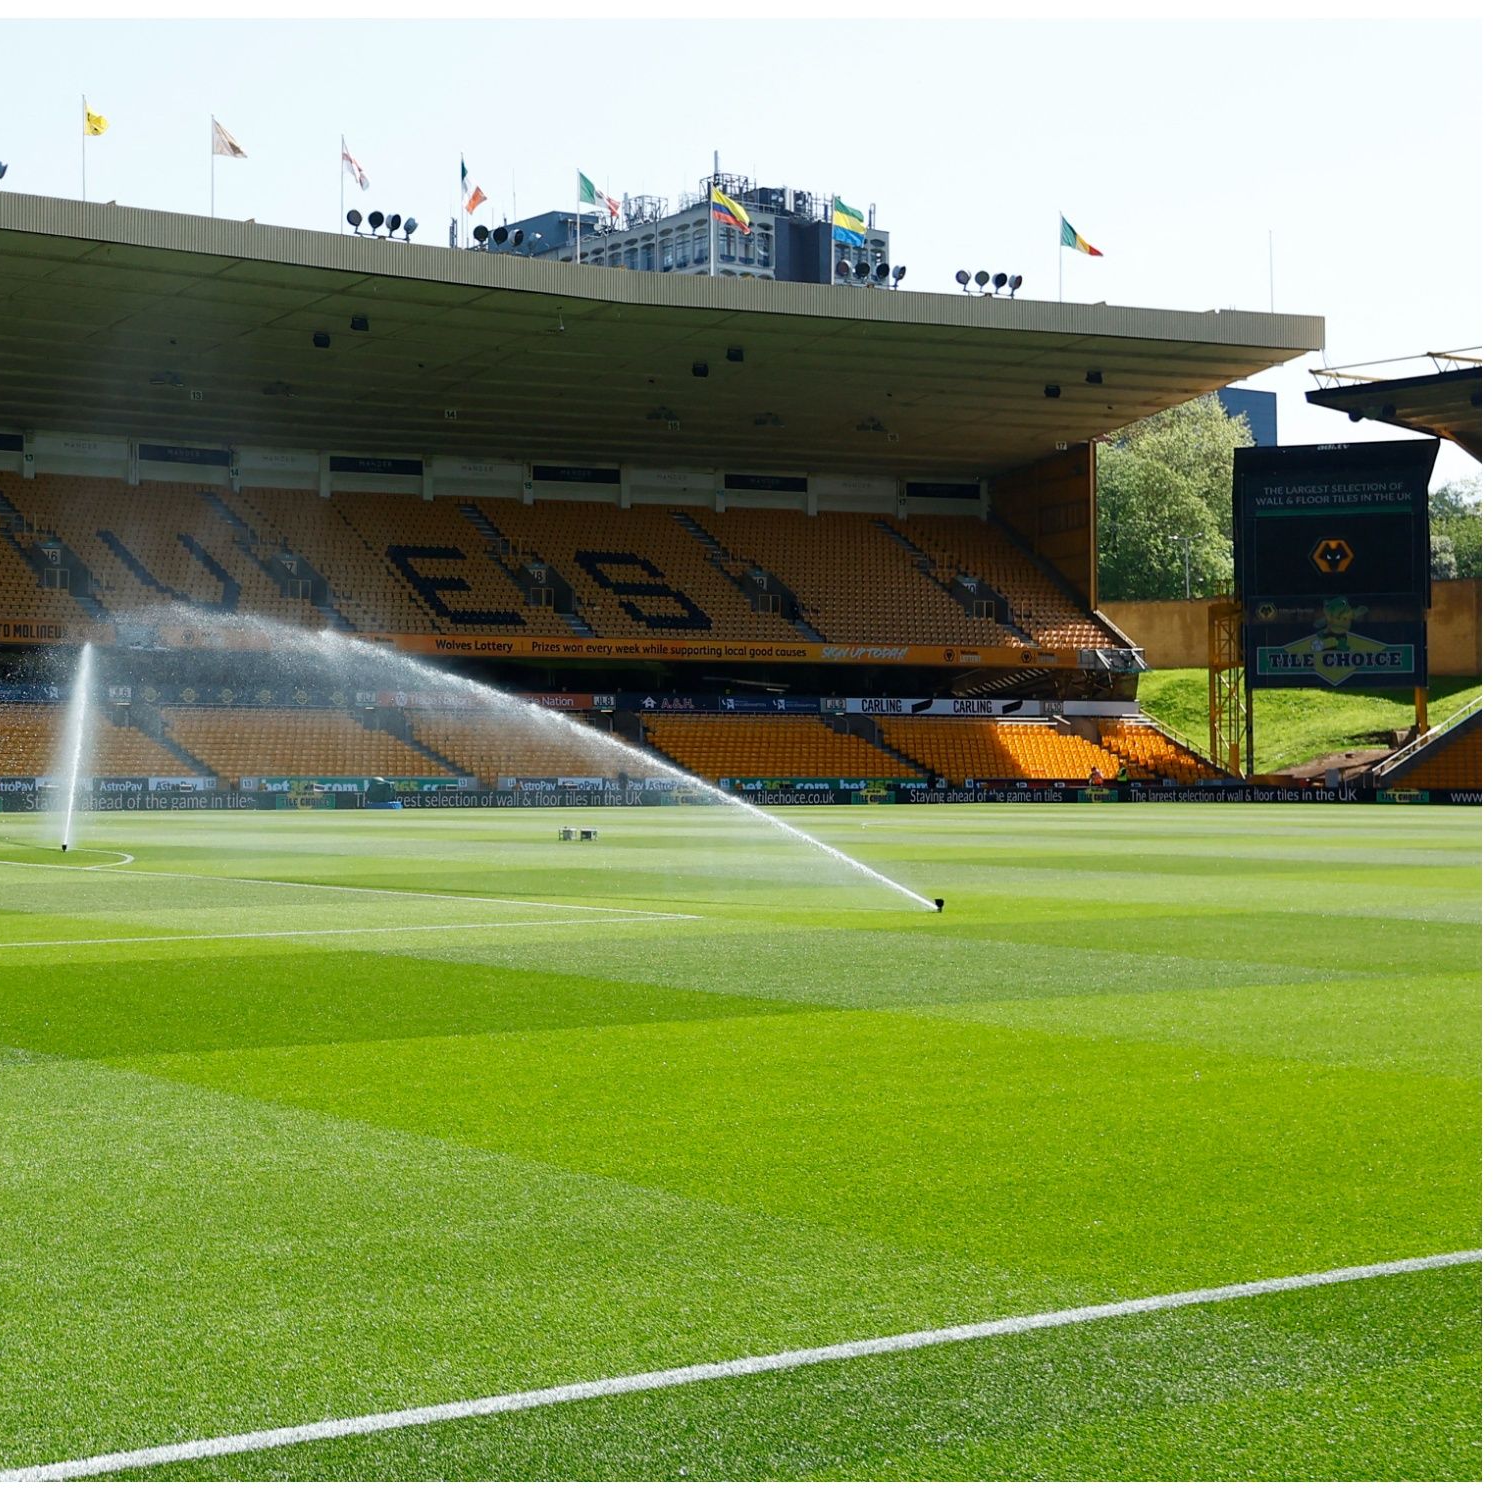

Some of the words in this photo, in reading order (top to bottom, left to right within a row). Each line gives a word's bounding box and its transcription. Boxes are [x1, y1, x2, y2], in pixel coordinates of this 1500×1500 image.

[231, 468, 239, 478] 14
[1264, 486, 1284, 496] THE
[1285, 483, 1329, 495] LARGEST
[1332, 481, 1387, 493] SELECTION
[1389, 481, 1404, 491] OF
[1256, 496, 1284, 506] WALL
[1286, 496, 1294, 505] &
[1296, 494, 1330, 505] FLOOR
[1333, 493, 1358, 503] TILES
[1360, 493, 1372, 502] IN
[1375, 492, 1393, 501] THE
[1396, 491, 1412, 501] UK
[436, 640, 471, 651] Wolves
[474, 641, 513, 654] Lottery
[532, 641, 560, 652] Prizes
[563, 643, 583, 653] won
[586, 644, 612, 656] every
[615, 643, 640, 654] week
[642, 644, 668, 655] while
[670, 645, 722, 657] supporting
[724, 646, 747, 656] local
[749, 647, 772, 658] good
[775, 649, 806, 657] causes
[820, 646, 850, 659] SIGN
[851, 647, 865, 658] UP
[1268, 653, 1314, 667] TILE
[1322, 651, 1402, 667] CHOICE
[542, 696, 573, 706] Nation
[861, 698, 901, 712] CARLING
[953, 699, 992, 713] CARLING
[100, 779, 142, 792] AstroPay
[124, 794, 141, 809] of
[146, 794, 167, 809] the
[171, 797, 207, 811] game
[211, 794, 222, 809] in
[425, 792, 477, 807] selection
[481, 792, 494, 806] of
[522, 792, 532, 806] &
[536, 792, 562, 806] floor
[565, 792, 588, 806] tiles
[591, 792, 600, 806] in
[604, 791, 622, 806] the
[626, 791, 643, 805] UK
[910, 789, 945, 804] Staying
[947, 789, 975, 803] ahead
[977, 789, 988, 802] of
[1007, 791, 1031, 804] game
[1034, 789, 1042, 802] in
[1044, 788, 1062, 802] tiles
[1131, 789, 1146, 802] The
[1149, 789, 1176, 803] largest
[1179, 789, 1215, 801] selection
[1216, 788, 1226, 801] of
[1227, 788, 1243, 801] wall
[1245, 789, 1251, 801] &
[1253, 788, 1275, 801] floor
[1277, 788, 1298, 801] tiles
[1301, 788, 1311, 801] in
[1314, 788, 1334, 801] the
[1337, 788, 1357, 801] UK
